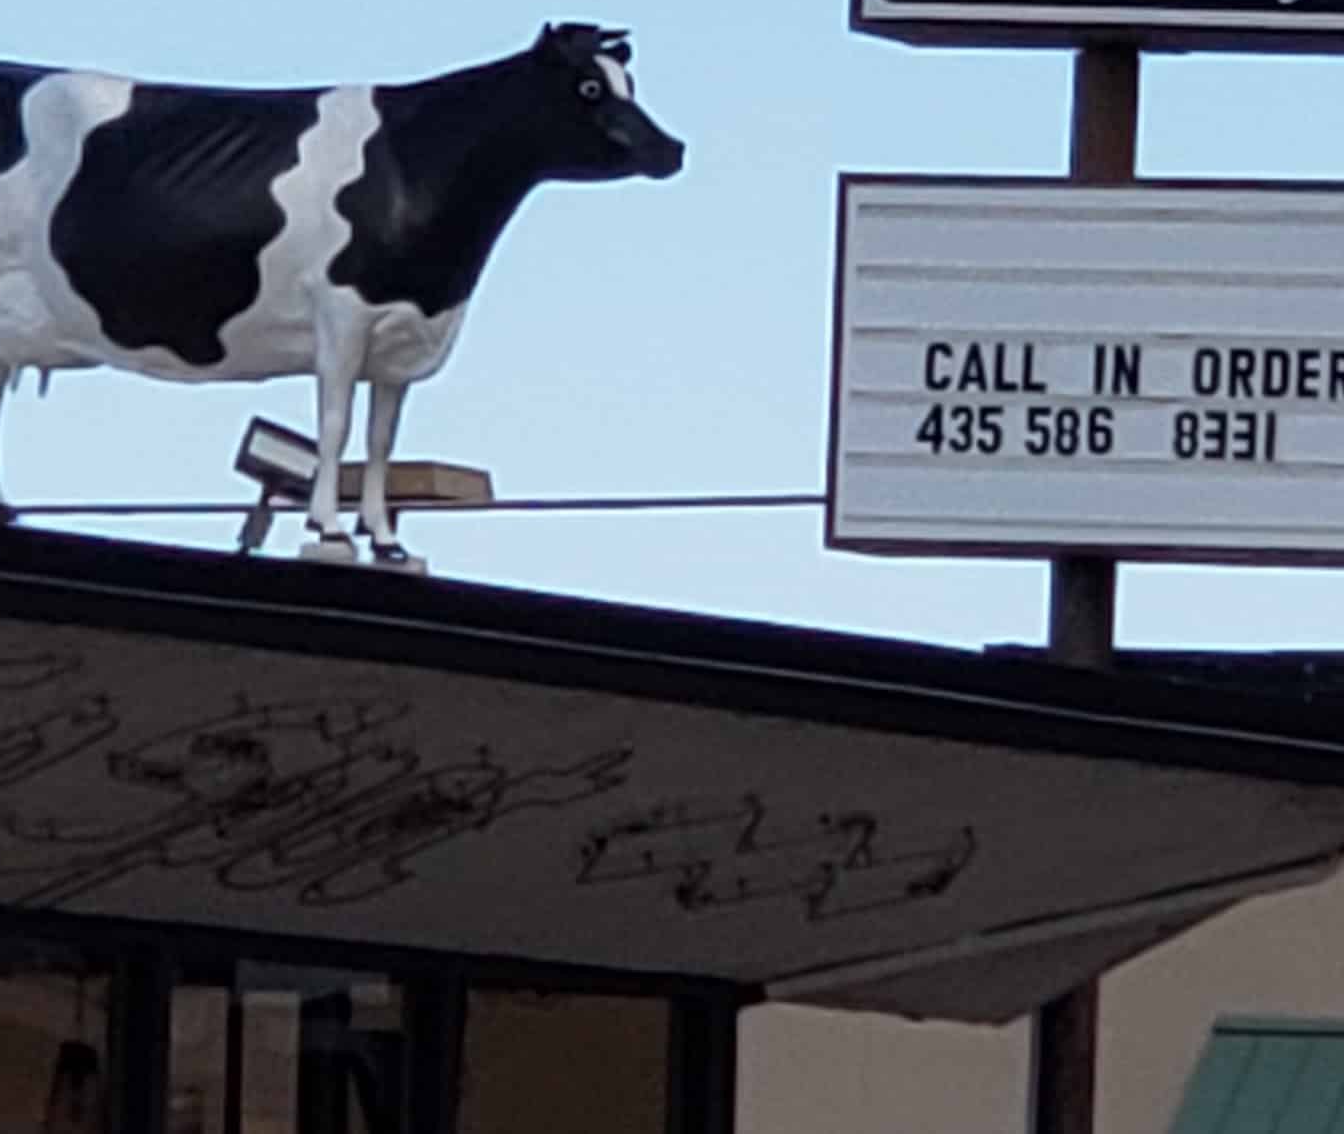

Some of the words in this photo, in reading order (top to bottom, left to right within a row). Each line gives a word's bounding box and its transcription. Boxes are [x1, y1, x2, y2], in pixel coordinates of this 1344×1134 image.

[923, 341, 1047, 395] CALL
[1092, 343, 1142, 397] IN
[916, 405, 1004, 456] 435
[1024, 406, 1115, 457] 586
[1172, 410, 1278, 463] 8331
